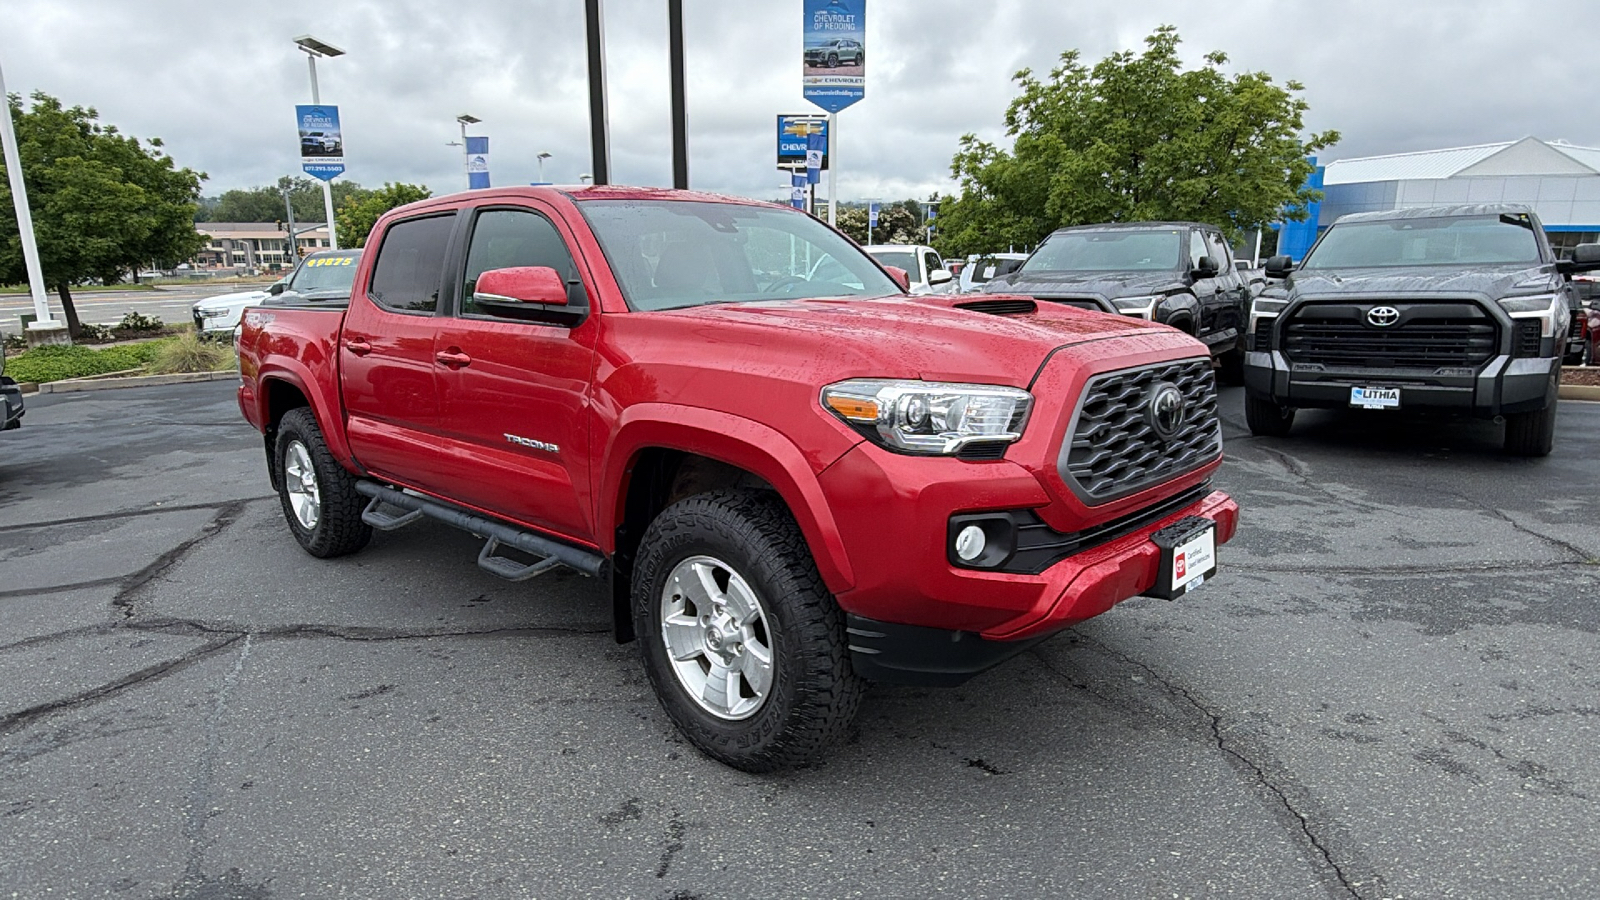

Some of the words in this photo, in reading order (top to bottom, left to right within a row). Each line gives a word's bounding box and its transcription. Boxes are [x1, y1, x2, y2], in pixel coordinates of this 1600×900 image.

[813, 14, 856, 23] CHEVROLET
[813, 23, 824, 31] OF
[824, 23, 856, 31] REDDING
[781, 143, 807, 151] CHEVR
[1362, 389, 1398, 400] LITHIA
[503, 433, 560, 453] TACOMA
